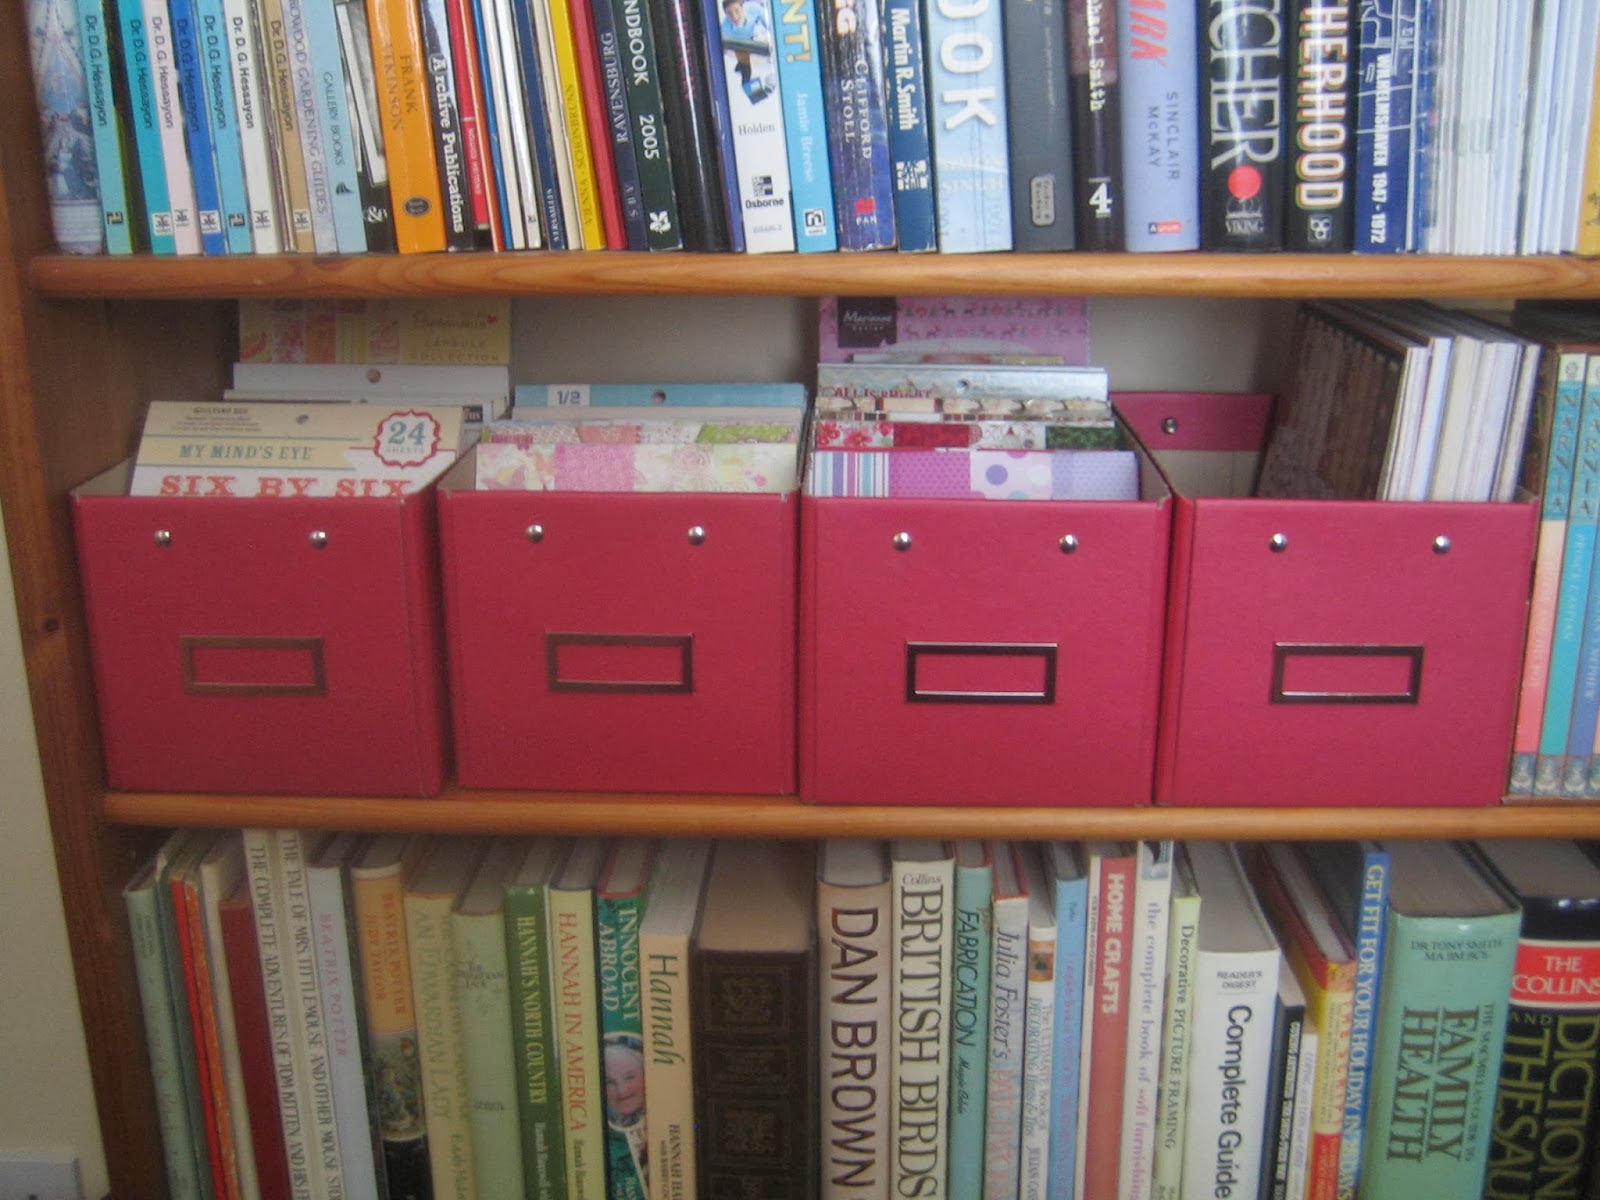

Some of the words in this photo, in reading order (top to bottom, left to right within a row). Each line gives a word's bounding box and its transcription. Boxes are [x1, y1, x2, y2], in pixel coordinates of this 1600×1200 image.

[891, 8, 912, 64] Martin
[91, 64, 108, 126] Hessayon
[137, 67, 153, 128] Hessayon
[158, 66, 174, 128] Hessayon
[184, 69, 200, 132] Hessayon
[211, 65, 228, 129] Hessayon
[238, 68, 254, 128] Hessayon
[278, 69, 294, 131] Hessayon
[324, 72, 339, 120] GALLERY
[400, 55, 416, 112] FRANK
[601, 33, 628, 144] RAVENSBURG
[1089, 58, 1105, 112] Smith
[1373, 53, 1390, 166] WILHELMSHAVEN
[639, 114, 659, 159] 2005
[738, 124, 775, 136] Holden
[797, 93, 810, 132] Jamie
[1166, 92, 1180, 180] SINCLAIR
[299, 67, 320, 156] GARDENING
[311, 161, 328, 214] GUIDES
[330, 125, 345, 167] BOOKS
[802, 136, 815, 182] Breese
[442, 132, 464, 232] Publications
[745, 198, 784, 209] Osborne
[1088, 183, 1112, 215] 4
[1372, 172, 1386, 201] 1947
[1225, 219, 1263, 233] VIKING
[1371, 213, 1386, 243] 1972
[180, 444, 206, 459] MY
[212, 445, 274, 460] MIND'S
[279, 446, 312, 461] EYE
[388, 421, 425, 446] 24
[160, 475, 238, 497] SIX
[257, 476, 320, 498] BY
[335, 478, 414, 499] SIX
[250, 848, 268, 872] THE
[282, 839, 299, 864] THE
[903, 872, 941, 885] Collins
[287, 871, 303, 900] TALE
[1106, 874, 1124, 932] HOME
[1366, 864, 1386, 902] GET
[256, 878, 277, 946] COMPLETE
[292, 905, 306, 922] OF
[1146, 902, 1162, 928] the
[1362, 906, 1382, 933] FIT
[320, 914, 338, 985] BEATRIX
[558, 912, 582, 1007] HANNAH
[600, 922, 618, 1010] ABROAD
[620, 907, 640, 1021] INNOCENT
[830, 907, 878, 1006] DAN
[899, 886, 944, 1064] BRITISH
[994, 928, 1020, 977] Julia
[1101, 938, 1121, 1014] CRAFTS
[1138, 936, 1159, 1014] complete
[1176, 925, 1195, 1004] Decorative
[1359, 938, 1378, 976] FOR
[1542, 955, 1583, 973] THE
[264, 956, 288, 1038] ADVENTURES
[955, 909, 980, 1047] FABRICATION
[1353, 978, 1375, 1030] YOUR
[1511, 973, 1600, 995] COLLINS
[328, 994, 347, 1056] POTTER
[524, 991, 543, 1038] NORTH
[566, 1013, 583, 1039] IN
[648, 953, 686, 1065] Hannah
[993, 984, 1019, 1059] Foster's
[275, 1042, 291, 1058] OF
[1138, 1020, 1154, 1059] book
[1170, 1008, 1186, 1075] PICTURE
[1218, 1005, 1252, 1124] Complete
[278, 1064, 294, 1088] TOM
[310, 1056, 326, 1080] AND
[526, 1042, 546, 1104] COUNTRY
[567, 1044, 588, 1131] AMERICA
[1137, 1067, 1152, 1083] of
[1345, 1034, 1369, 1110] HOLIDAY
[1387, 1006, 1439, 1162] HEALTH
[1428, 1006, 1480, 1162] FAMILY
[283, 1092, 300, 1136] KITTEN
[314, 1083, 332, 1124] OTHER
[830, 1020, 878, 1188] BROWN
[1135, 1088, 1150, 1116] soft
[1164, 1079, 1180, 1150] FRAMING
[1343, 1114, 1361, 1131] IN
[290, 1142, 306, 1166] AND
[322, 1131, 338, 1170] MOUSE
[669, 1124, 682, 1178] HANNAH
[897, 1075, 939, 1199] BIRDS
[1214, 1130, 1242, 1200] Guide
